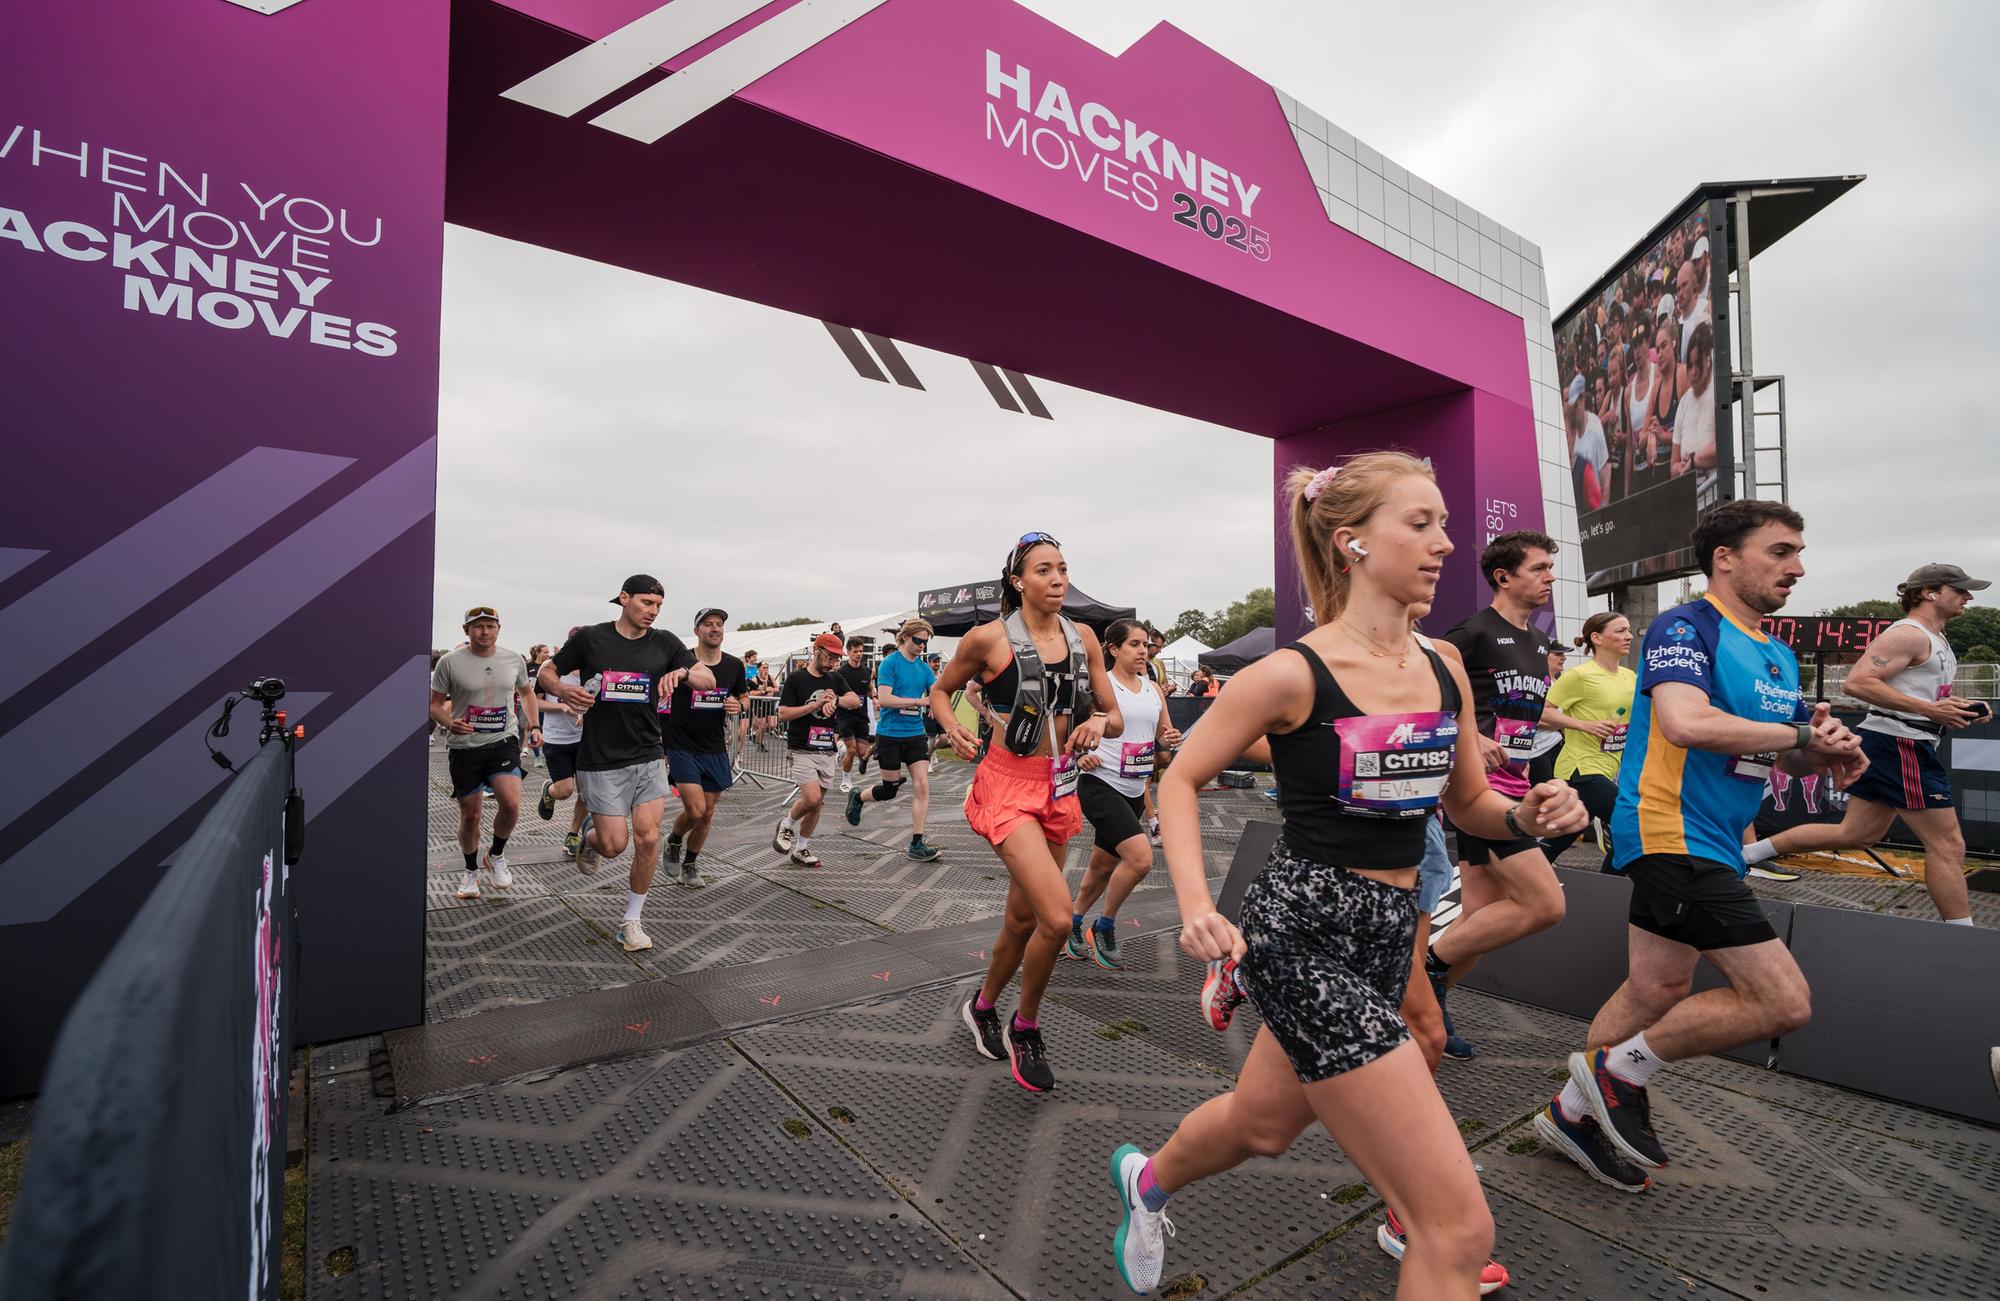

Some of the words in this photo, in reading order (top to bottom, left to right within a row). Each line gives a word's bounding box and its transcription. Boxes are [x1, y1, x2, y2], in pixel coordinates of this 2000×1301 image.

[986, 48, 1261, 218] HACKNEY
[986, 101, 1159, 212] MOVES
[1172, 192, 1271, 262] 2025
[240, 182, 382, 246] YOU
[113, 191, 330, 274] MOVE
[124, 274, 398, 357] MOVES
[1486, 498, 1517, 518] LET'S
[1486, 515, 1504, 531] GO
[1494, 670, 1509, 679] LET'S
[1649, 654, 1703, 676] Society
[1760, 695, 1793, 720] Society
[1435, 726, 1458, 737] 2025
[1385, 750, 1449, 770] C17182
[1379, 781, 1413, 799] EVA
